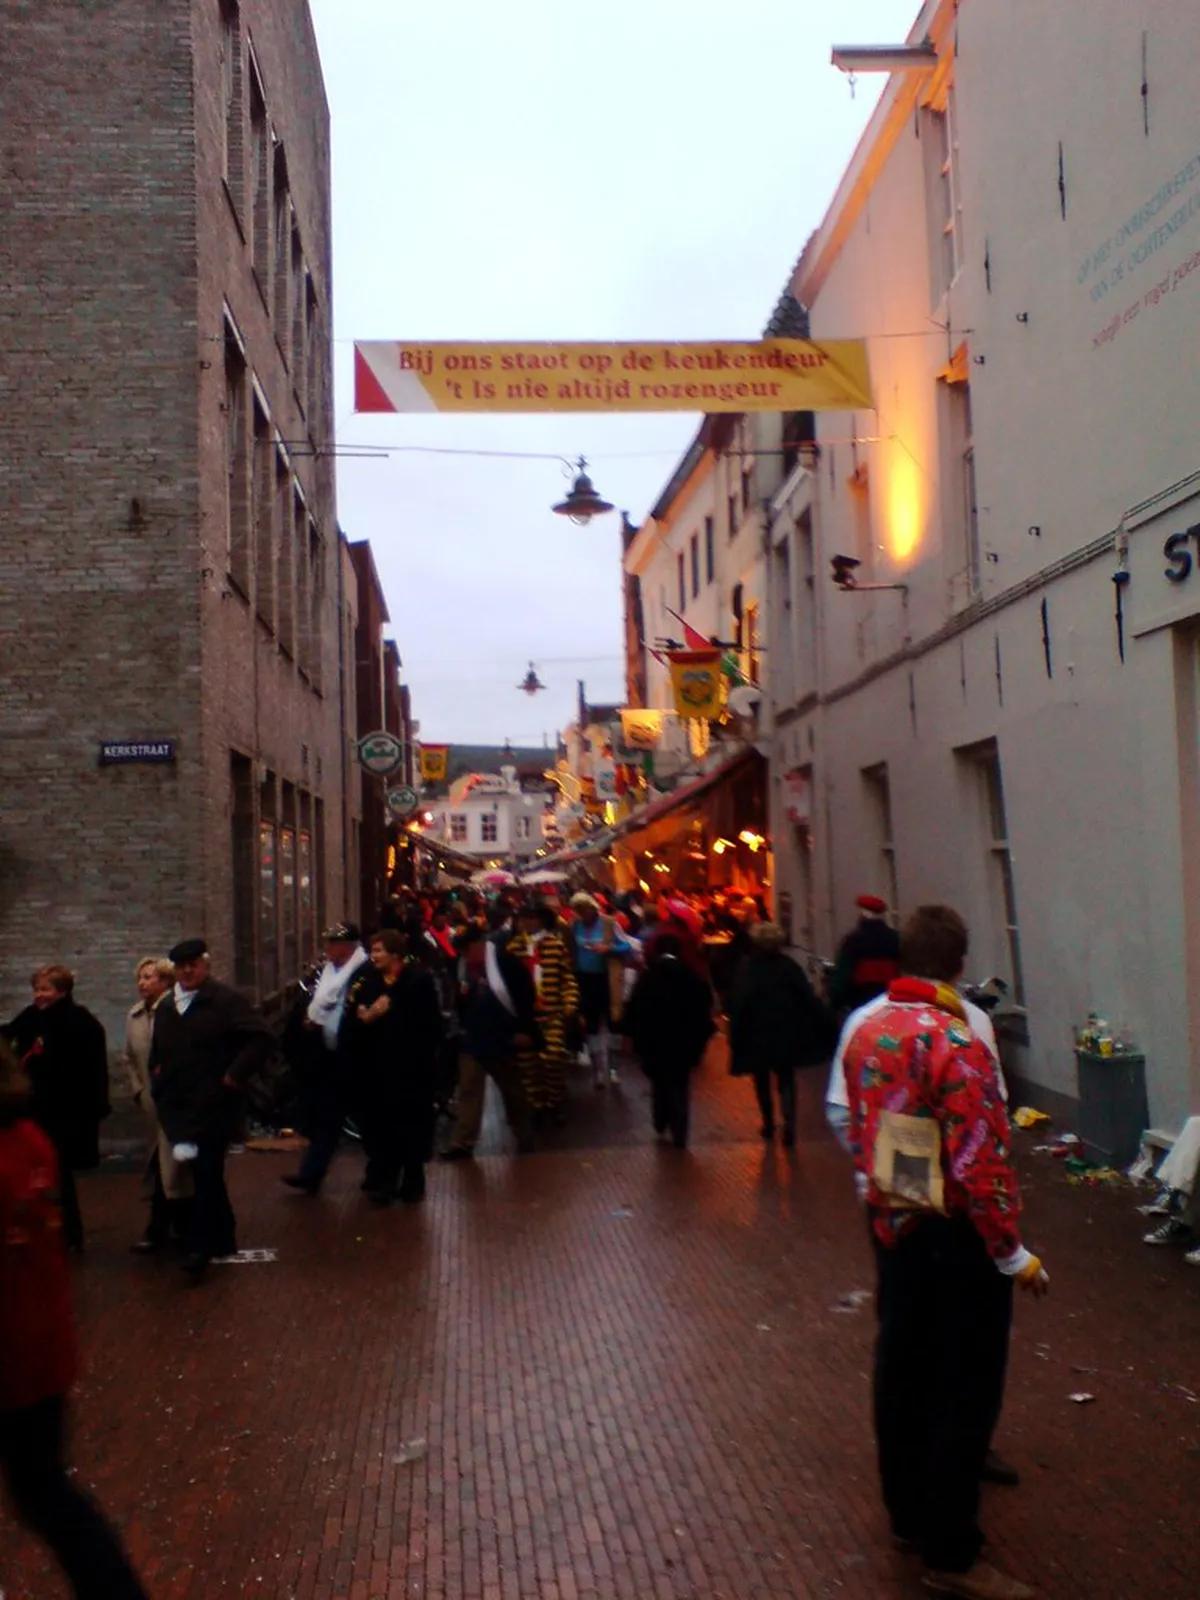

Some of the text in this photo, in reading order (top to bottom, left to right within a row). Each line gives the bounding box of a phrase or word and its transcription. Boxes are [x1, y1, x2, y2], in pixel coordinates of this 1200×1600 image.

[400, 350, 434, 375] Bij
[443, 353, 494, 371] ons
[577, 352, 614, 374] op
[621, 349, 655, 371] de
[663, 348, 830, 371] keukendeur
[506, 377, 550, 400] nie
[557, 378, 631, 403] altijd
[639, 380, 783, 401] rozengeur
[103, 744, 169, 757] KERKSTRAAT
